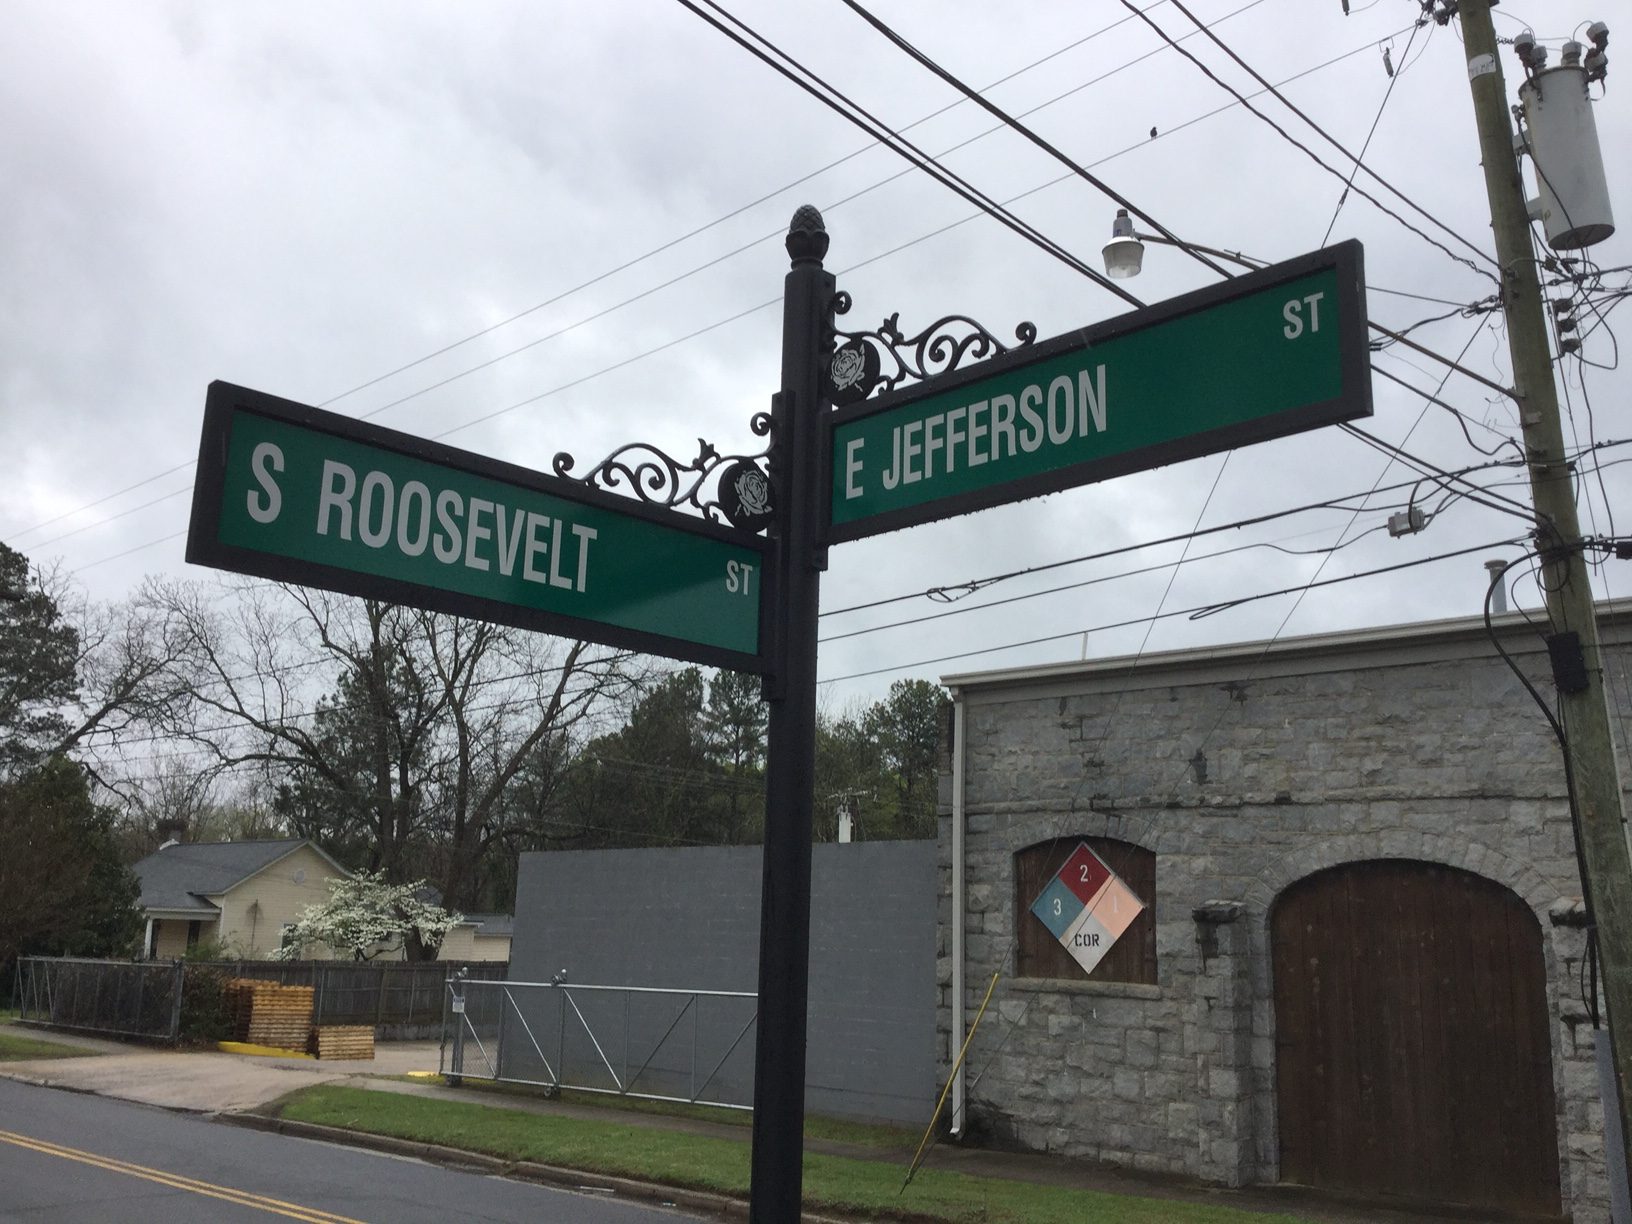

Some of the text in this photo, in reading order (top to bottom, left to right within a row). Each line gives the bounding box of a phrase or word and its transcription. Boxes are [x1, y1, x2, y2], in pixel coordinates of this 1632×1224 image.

[845, 291, 1324, 500] E JEFFERSON ST
[246, 441, 753, 597] S ROOSEVELT ST
[1079, 864, 1089, 882] 2
[1053, 898, 1062, 916] 3
[1074, 933, 1100, 947] COR
